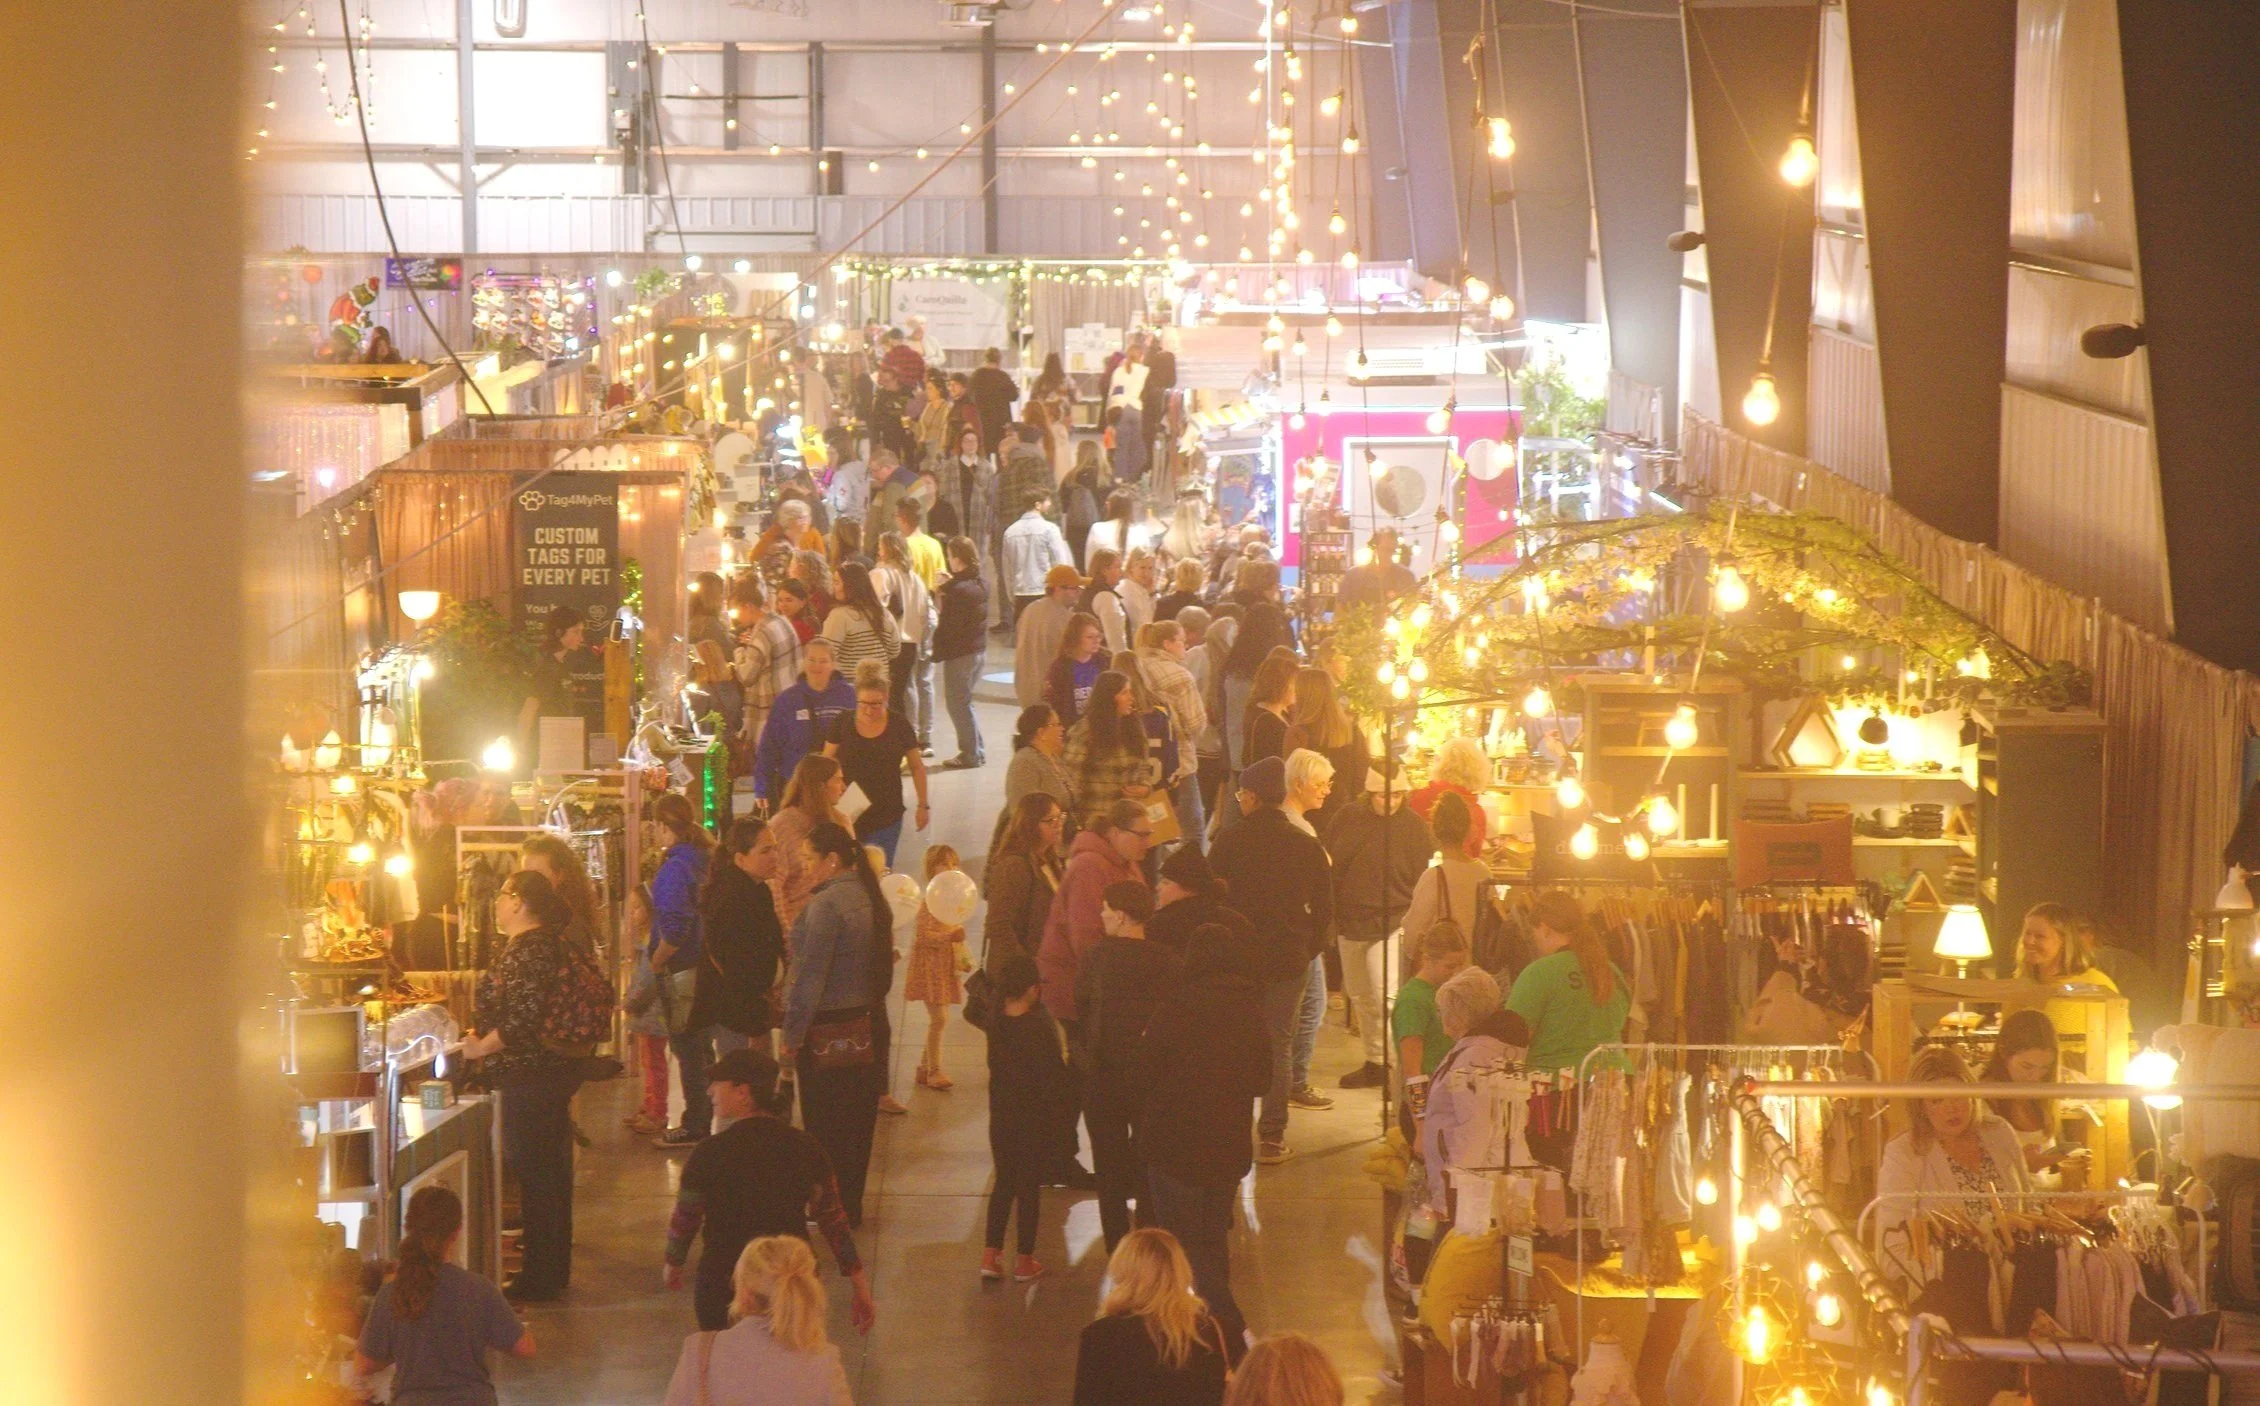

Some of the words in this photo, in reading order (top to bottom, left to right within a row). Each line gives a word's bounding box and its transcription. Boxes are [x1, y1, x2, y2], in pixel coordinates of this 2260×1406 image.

[546, 494, 613, 507] Tag4MyPet
[534, 527, 598, 544] CUSTOM
[527, 548, 570, 564] TAGS
[575, 548, 606, 564] FOR
[523, 568, 576, 585] EVERY
[580, 568, 611, 585] PET
[525, 603, 549, 614] You
